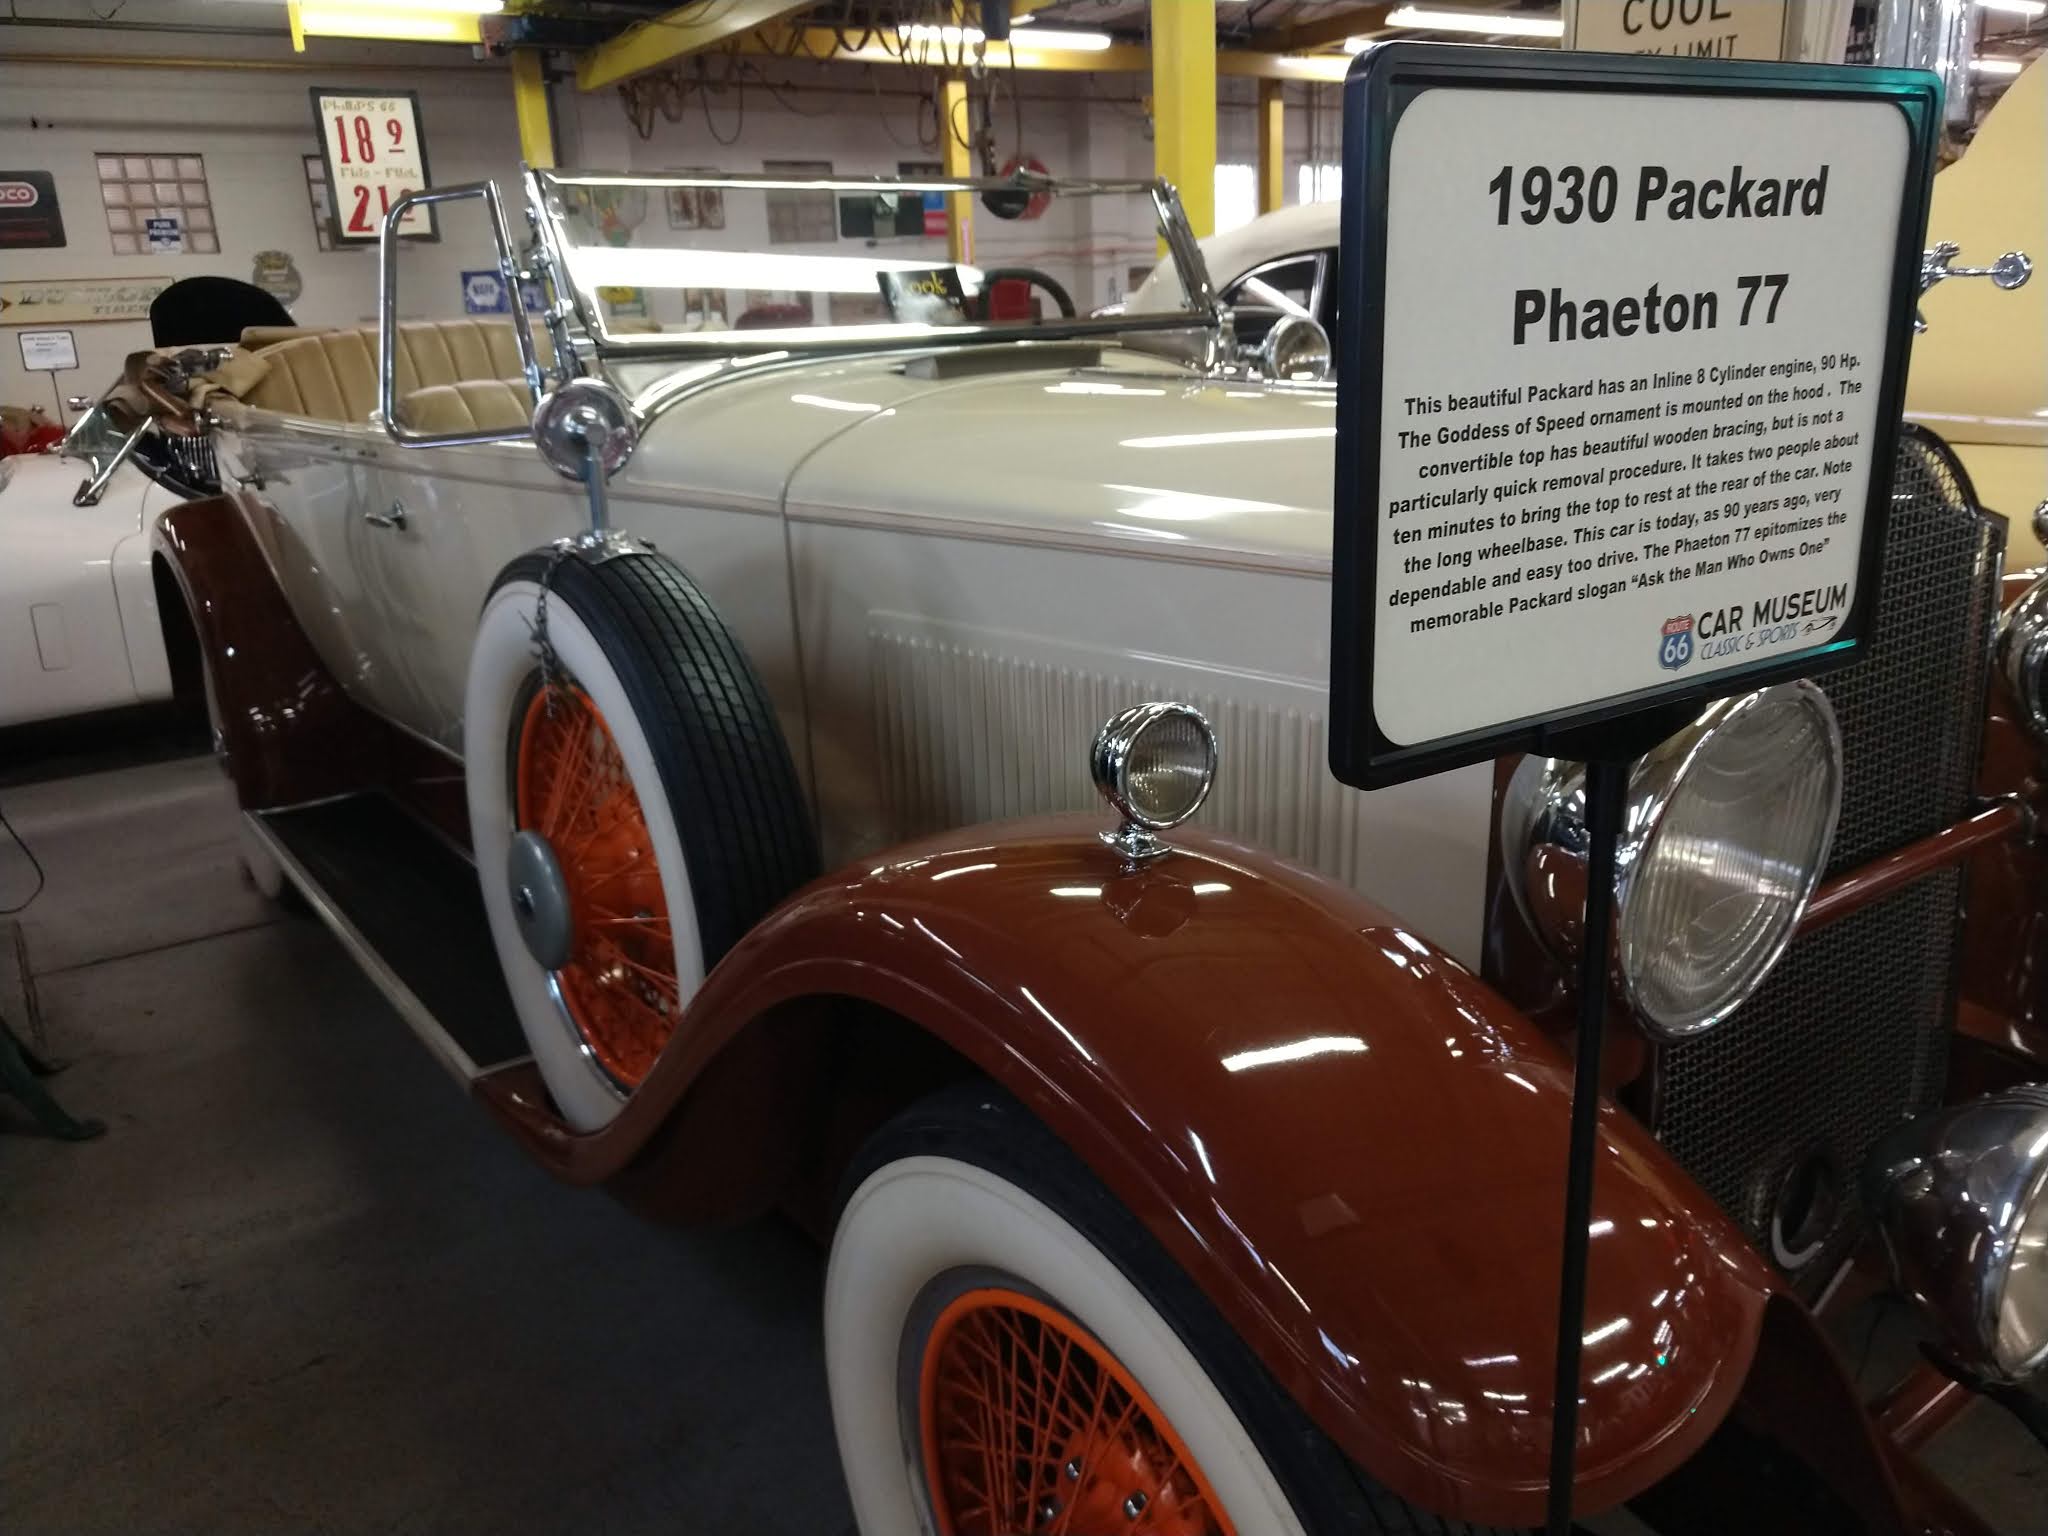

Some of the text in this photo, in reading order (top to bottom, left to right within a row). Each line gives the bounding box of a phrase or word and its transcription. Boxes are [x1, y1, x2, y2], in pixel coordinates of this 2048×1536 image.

[334, 115, 375, 163] 18
[1488, 164, 1829, 225] 1930 Packard
[1513, 273, 1789, 345] Phaeton 77
[1397, 430, 1431, 449] The
[1436, 422, 1509, 444] Goddess
[1514, 416, 1532, 434] of
[1535, 410, 1585, 435] Speed
[1589, 402, 1661, 426] ornament
[1665, 400, 1678, 416] is
[1681, 392, 1743, 414] mounted
[1746, 393, 1763, 406] on
[1767, 388, 1788, 404] the
[1792, 382, 1824, 400] hood
[1839, 379, 1861, 395] The
[1404, 352, 1860, 415] This beautiful Packard has an Inline 8 Cylinder engine, 90 Hp.
[1388, 432, 1858, 518] particularly quick removal procedure. It takes two people about
[1418, 409, 1843, 478] convertible top has beautiful wooden bracing, but is not a
[1392, 460, 1851, 544] ten minutes to bring the top to rest at the rear of the car. Note
[1403, 488, 1841, 573] the long wheelbase. This car is today, as 90 years ago, very
[1388, 510, 1846, 606] dependable and easy too drive. The Phaeton 77 epitomizes the
[1410, 601, 1503, 633] memorable
[1508, 586, 1572, 613] Packard
[1577, 580, 1626, 599] slogan
[1668, 566, 1691, 582] the
[1694, 560, 1722, 576] Man
[1727, 553, 1754, 570] Who
[1758, 547, 1794, 563] Owns
[1667, 620, 1691, 631] ROUTE
[1697, 583, 1846, 639] CAR MUSEUM
[1701, 634, 1744, 660] CLASSIC
[1756, 621, 1800, 648] SPORTS
[1664, 638, 1689, 662] 66
